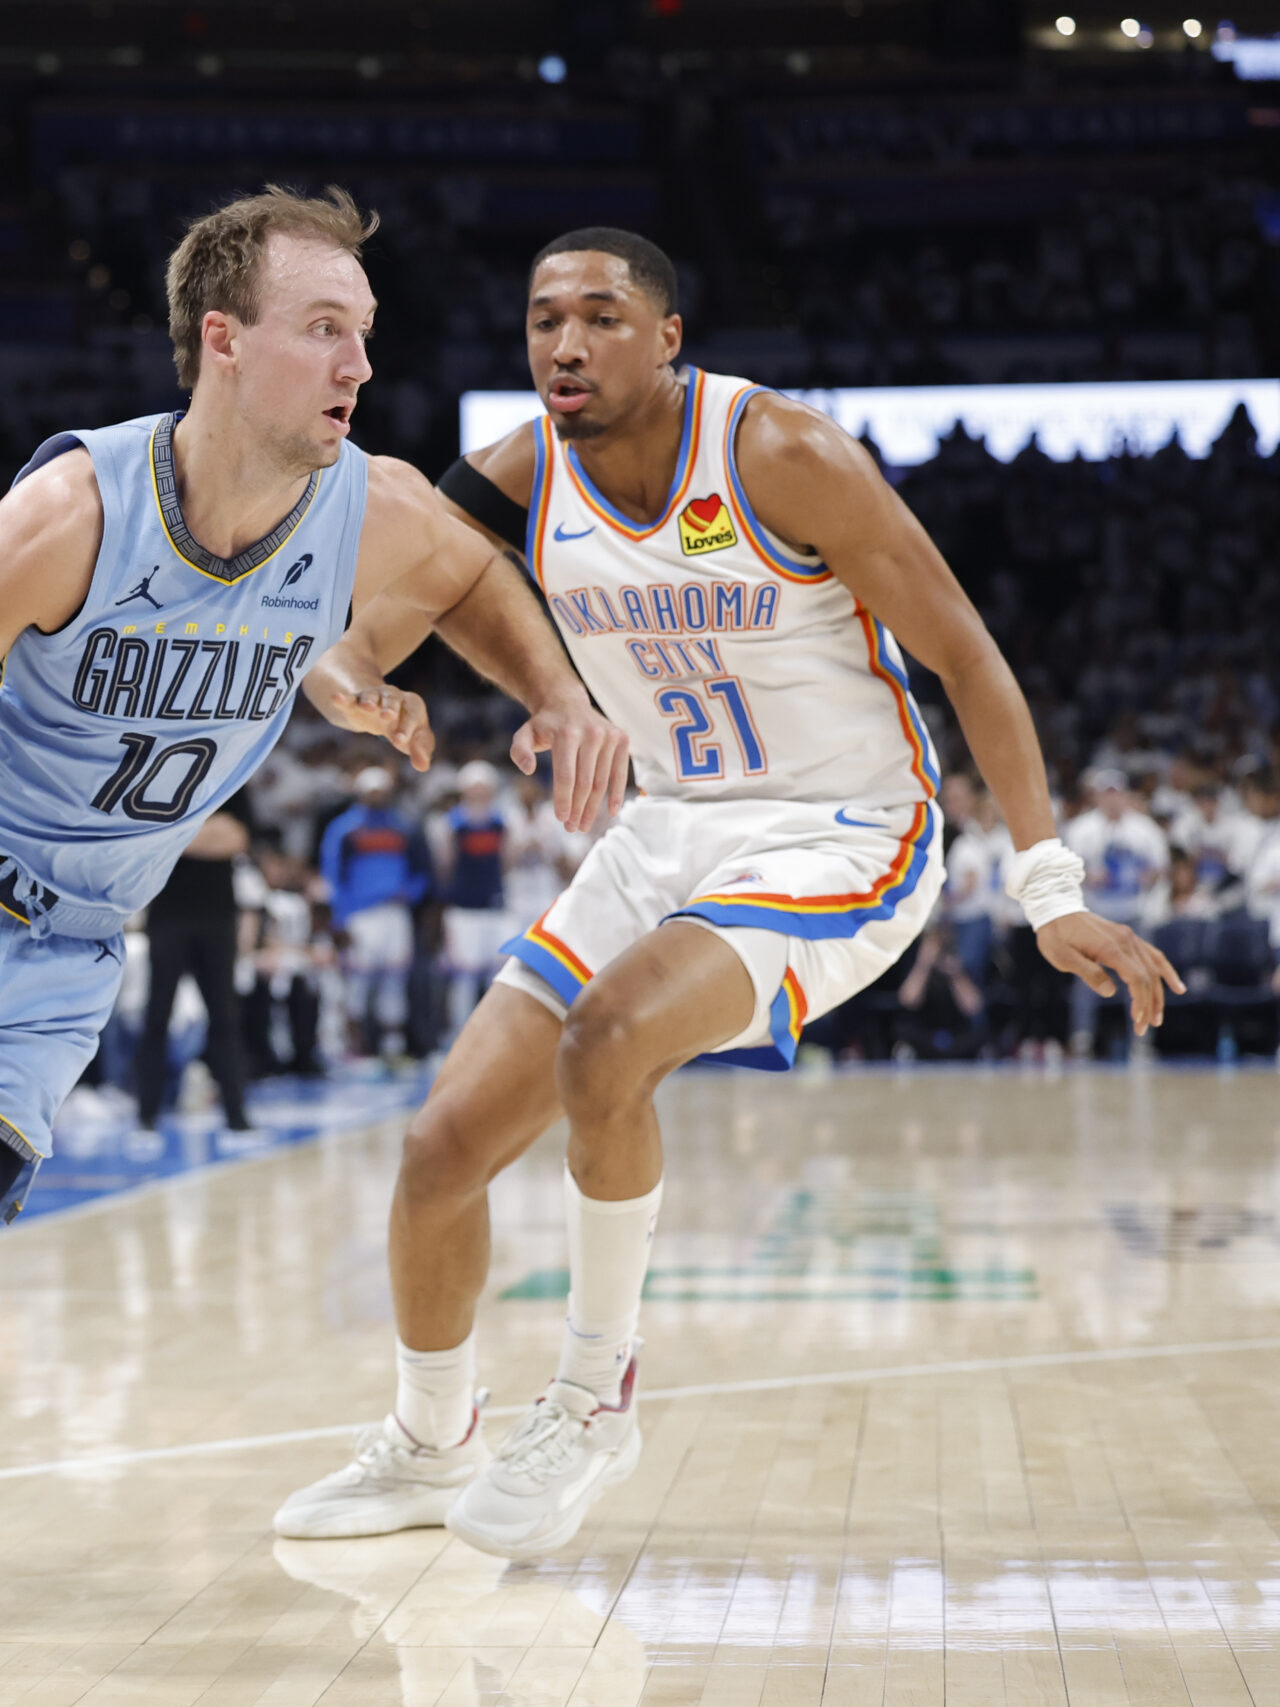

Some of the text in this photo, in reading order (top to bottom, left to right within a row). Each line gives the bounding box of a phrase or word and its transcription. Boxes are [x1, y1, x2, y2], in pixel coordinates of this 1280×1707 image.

[685, 526, 733, 550] Love's
[261, 595, 319, 610] Robinhood
[548, 581, 780, 637] OKLAHOMA
[122, 622, 293, 643] MEMPHIS
[72, 627, 314, 721] GRIZZLIES
[626, 637, 728, 680] CITY
[655, 675, 768, 783] 21
[90, 732, 217, 824] 10
